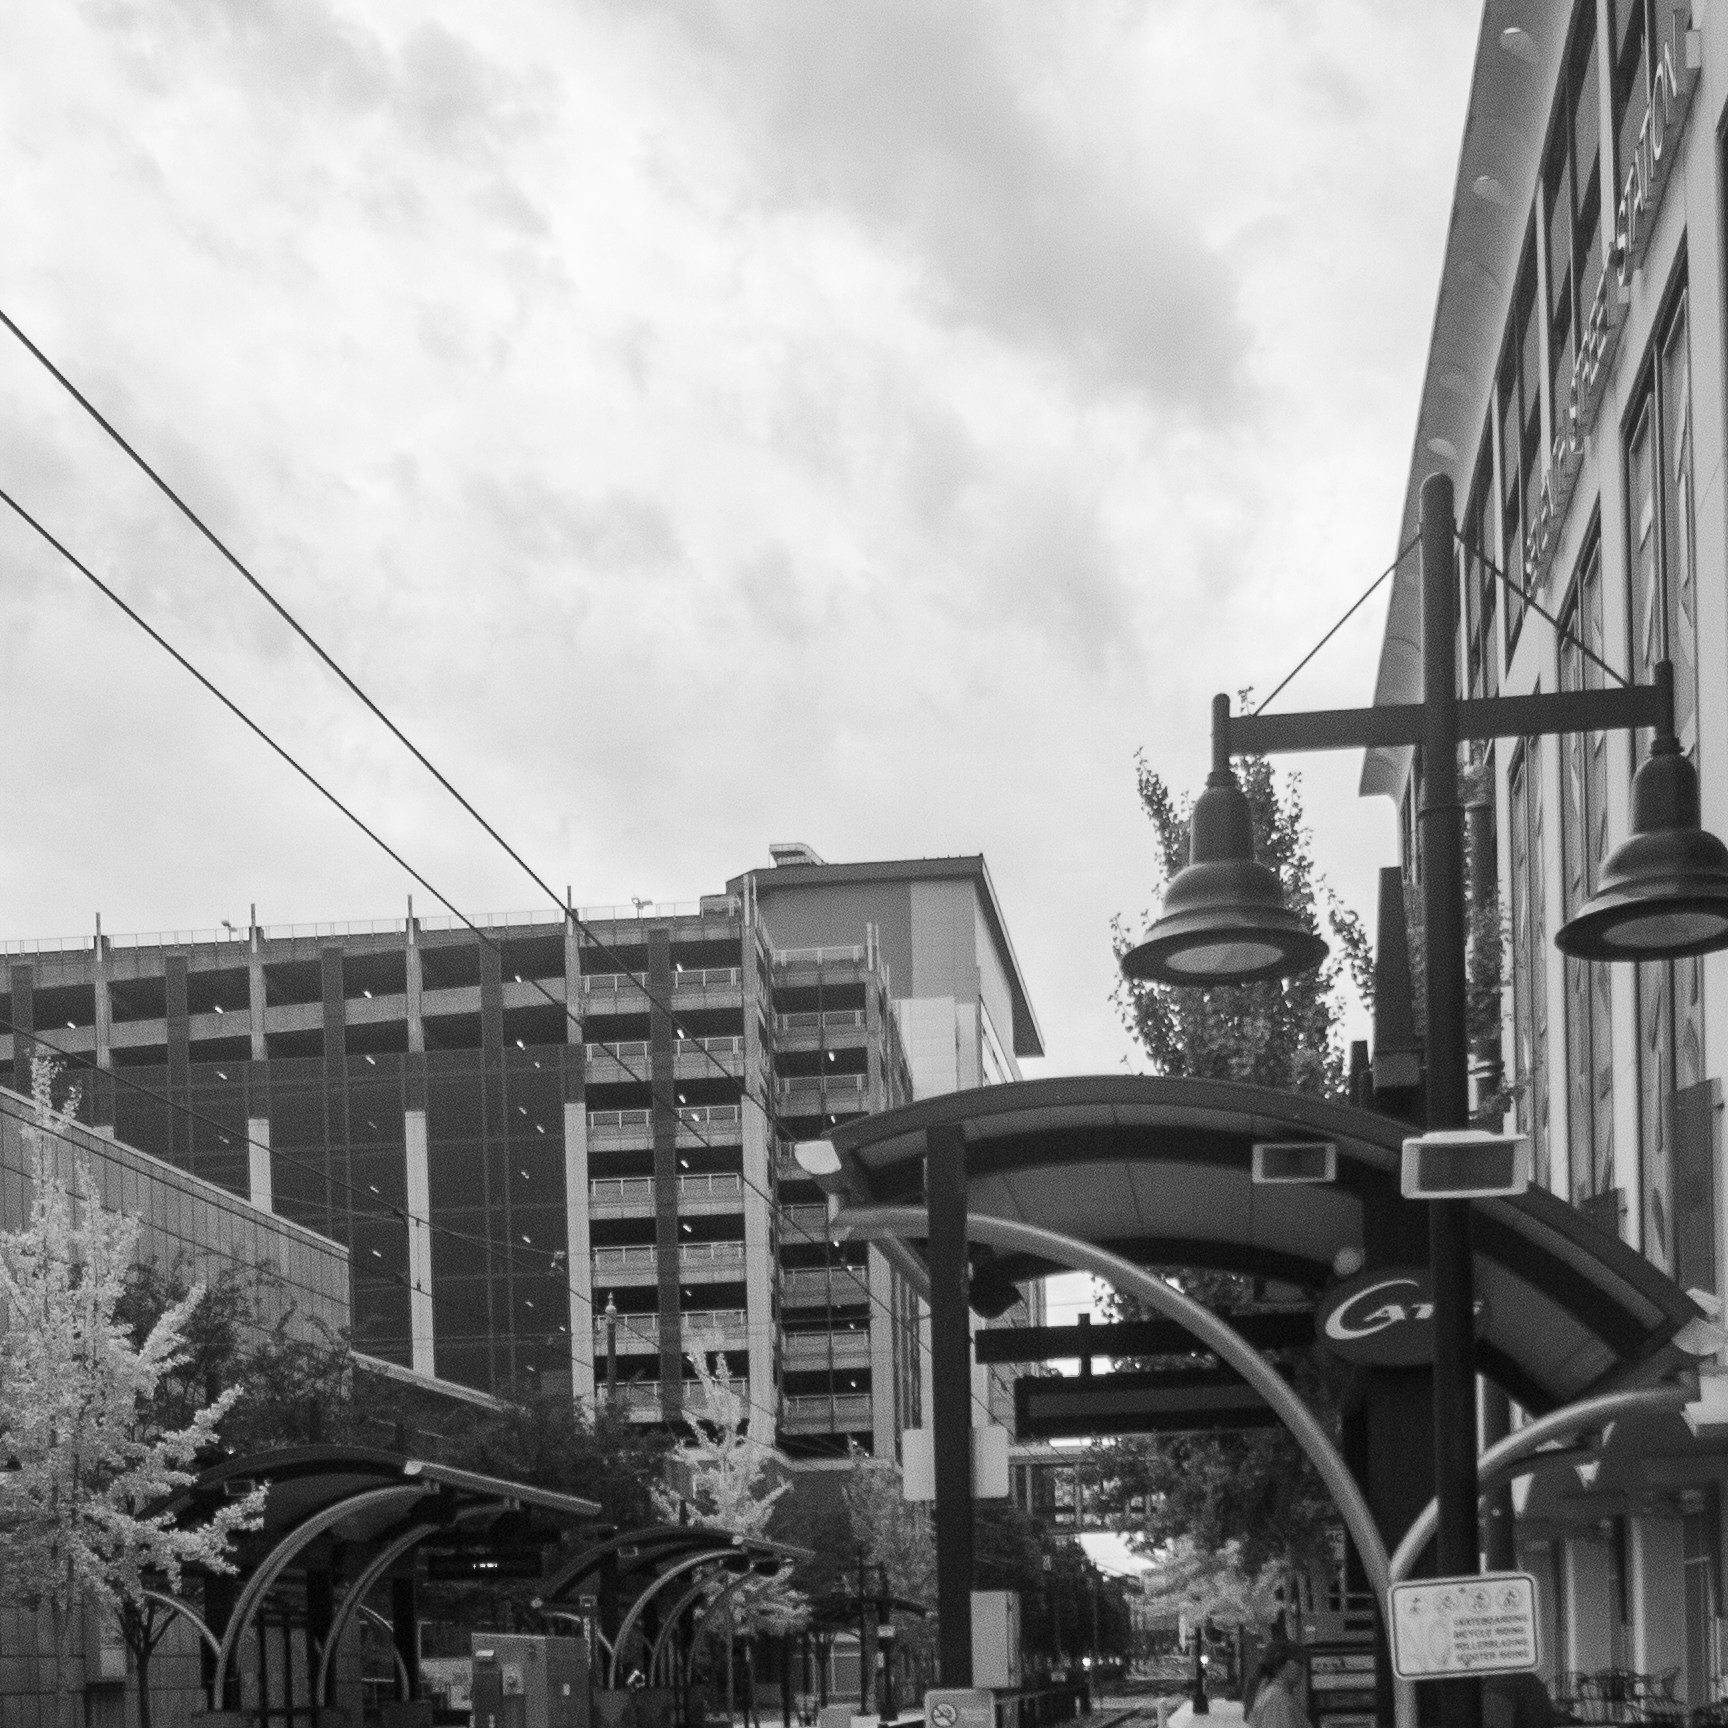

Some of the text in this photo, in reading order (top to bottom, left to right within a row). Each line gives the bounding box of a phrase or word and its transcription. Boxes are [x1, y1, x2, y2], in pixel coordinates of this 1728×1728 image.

[1614, 13, 1677, 288] STATION
[1323, 1277, 1481, 1341] CAT
[1453, 1615, 1528, 1627] SKATEBOARDING
[1453, 1629, 1491, 1639] BICYCLE
